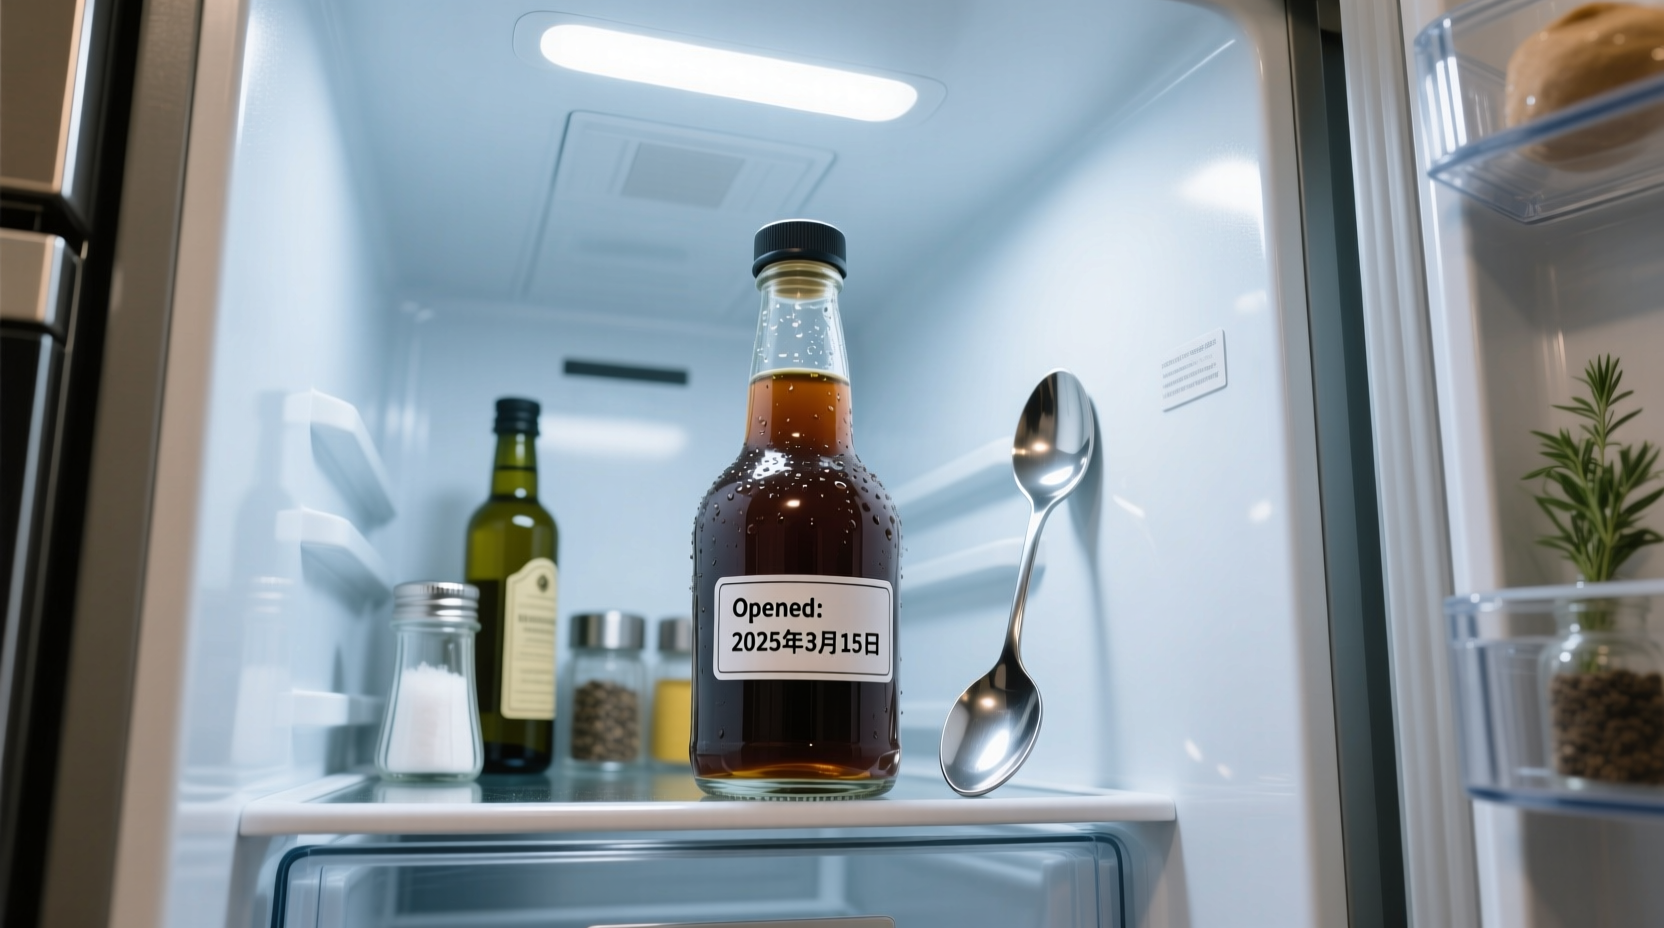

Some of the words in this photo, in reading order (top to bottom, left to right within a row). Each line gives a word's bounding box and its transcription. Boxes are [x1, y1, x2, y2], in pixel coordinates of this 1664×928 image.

[732, 597, 823, 624] Opened:
[731, 629, 880, 656] 2025年3月15日
